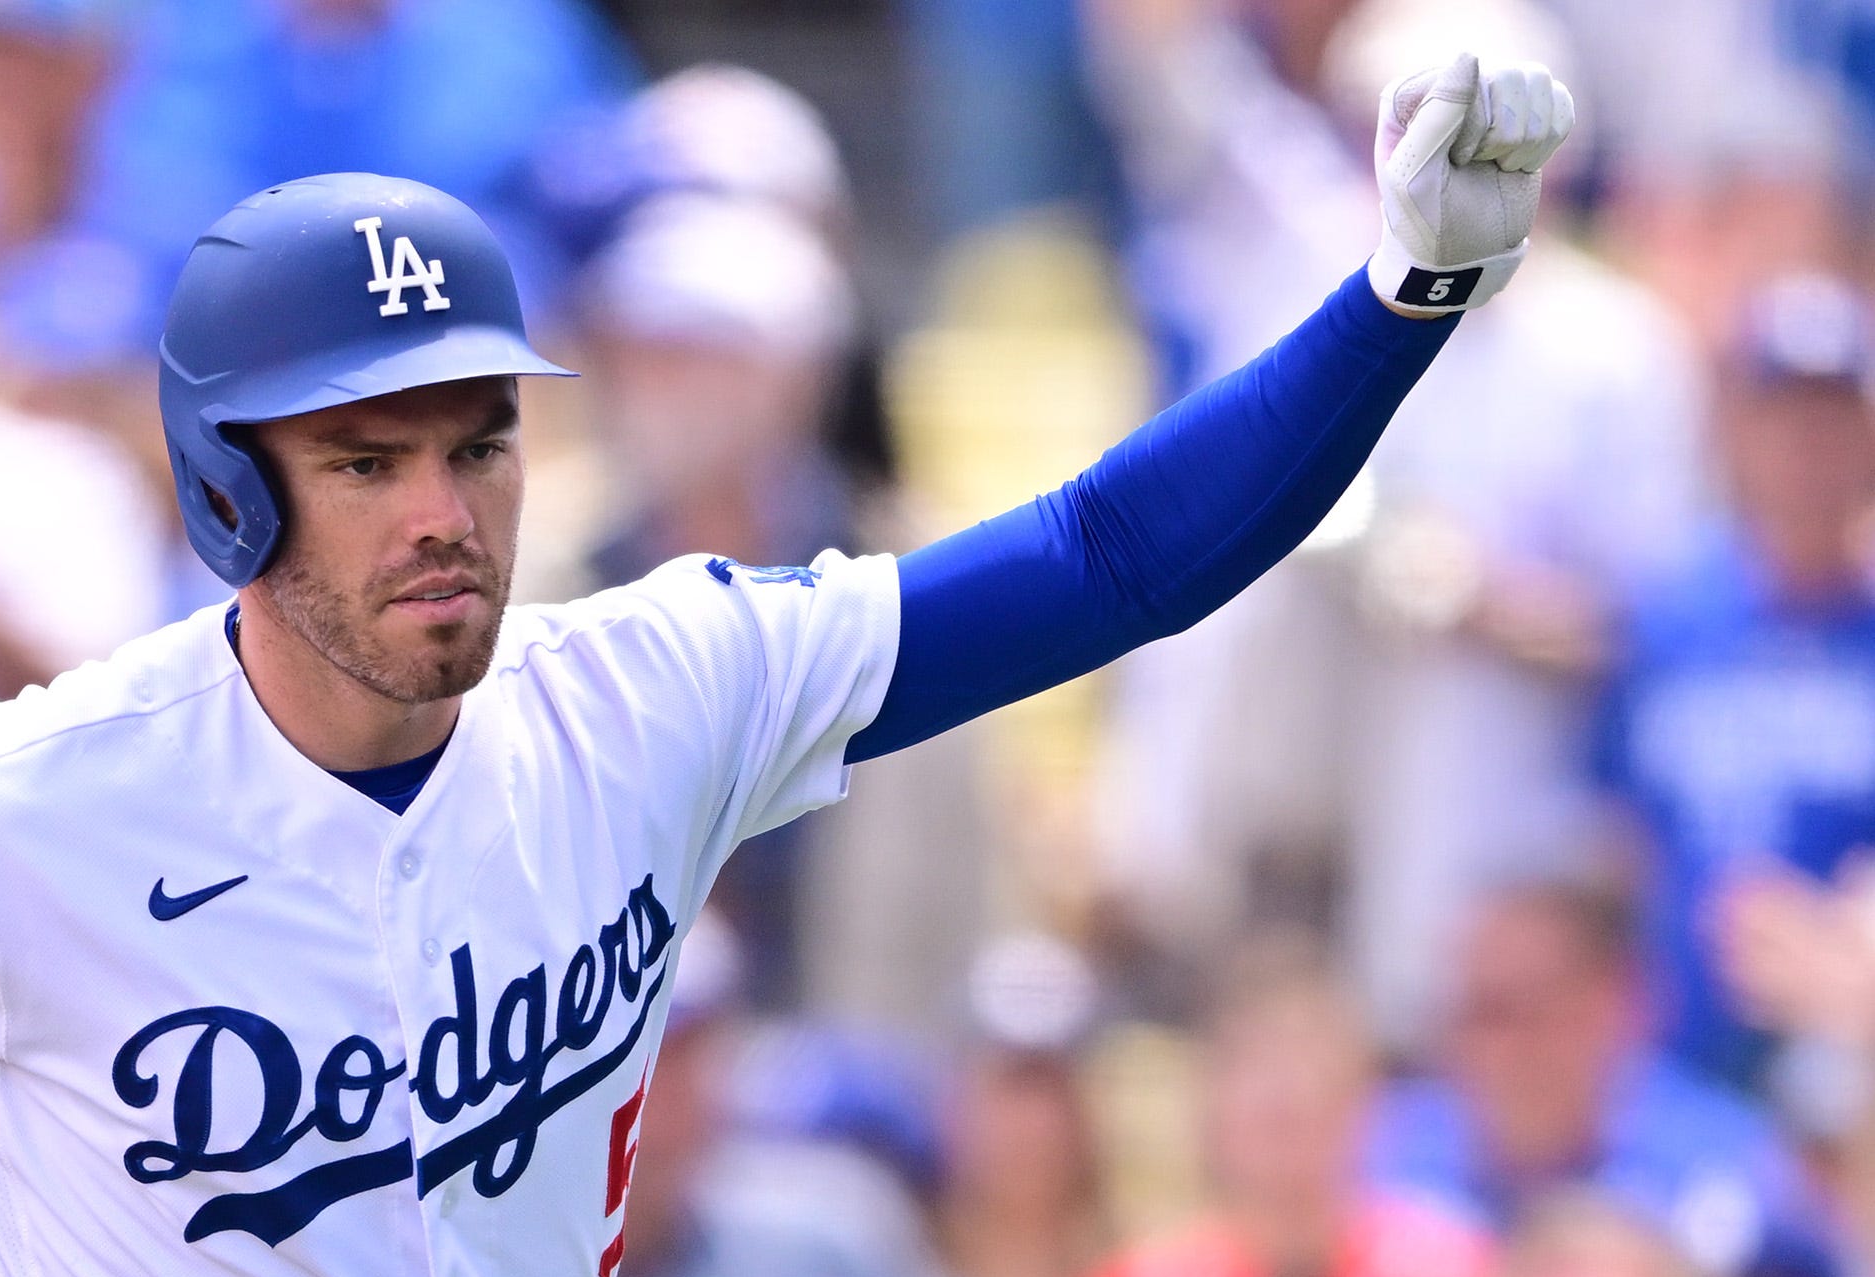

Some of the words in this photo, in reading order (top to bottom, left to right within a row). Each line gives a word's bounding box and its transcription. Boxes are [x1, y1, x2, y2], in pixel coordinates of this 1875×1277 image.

[354, 216, 451, 317] LA
[1427, 277, 1455, 301] 5
[112, 873, 677, 1199] Dodgers
